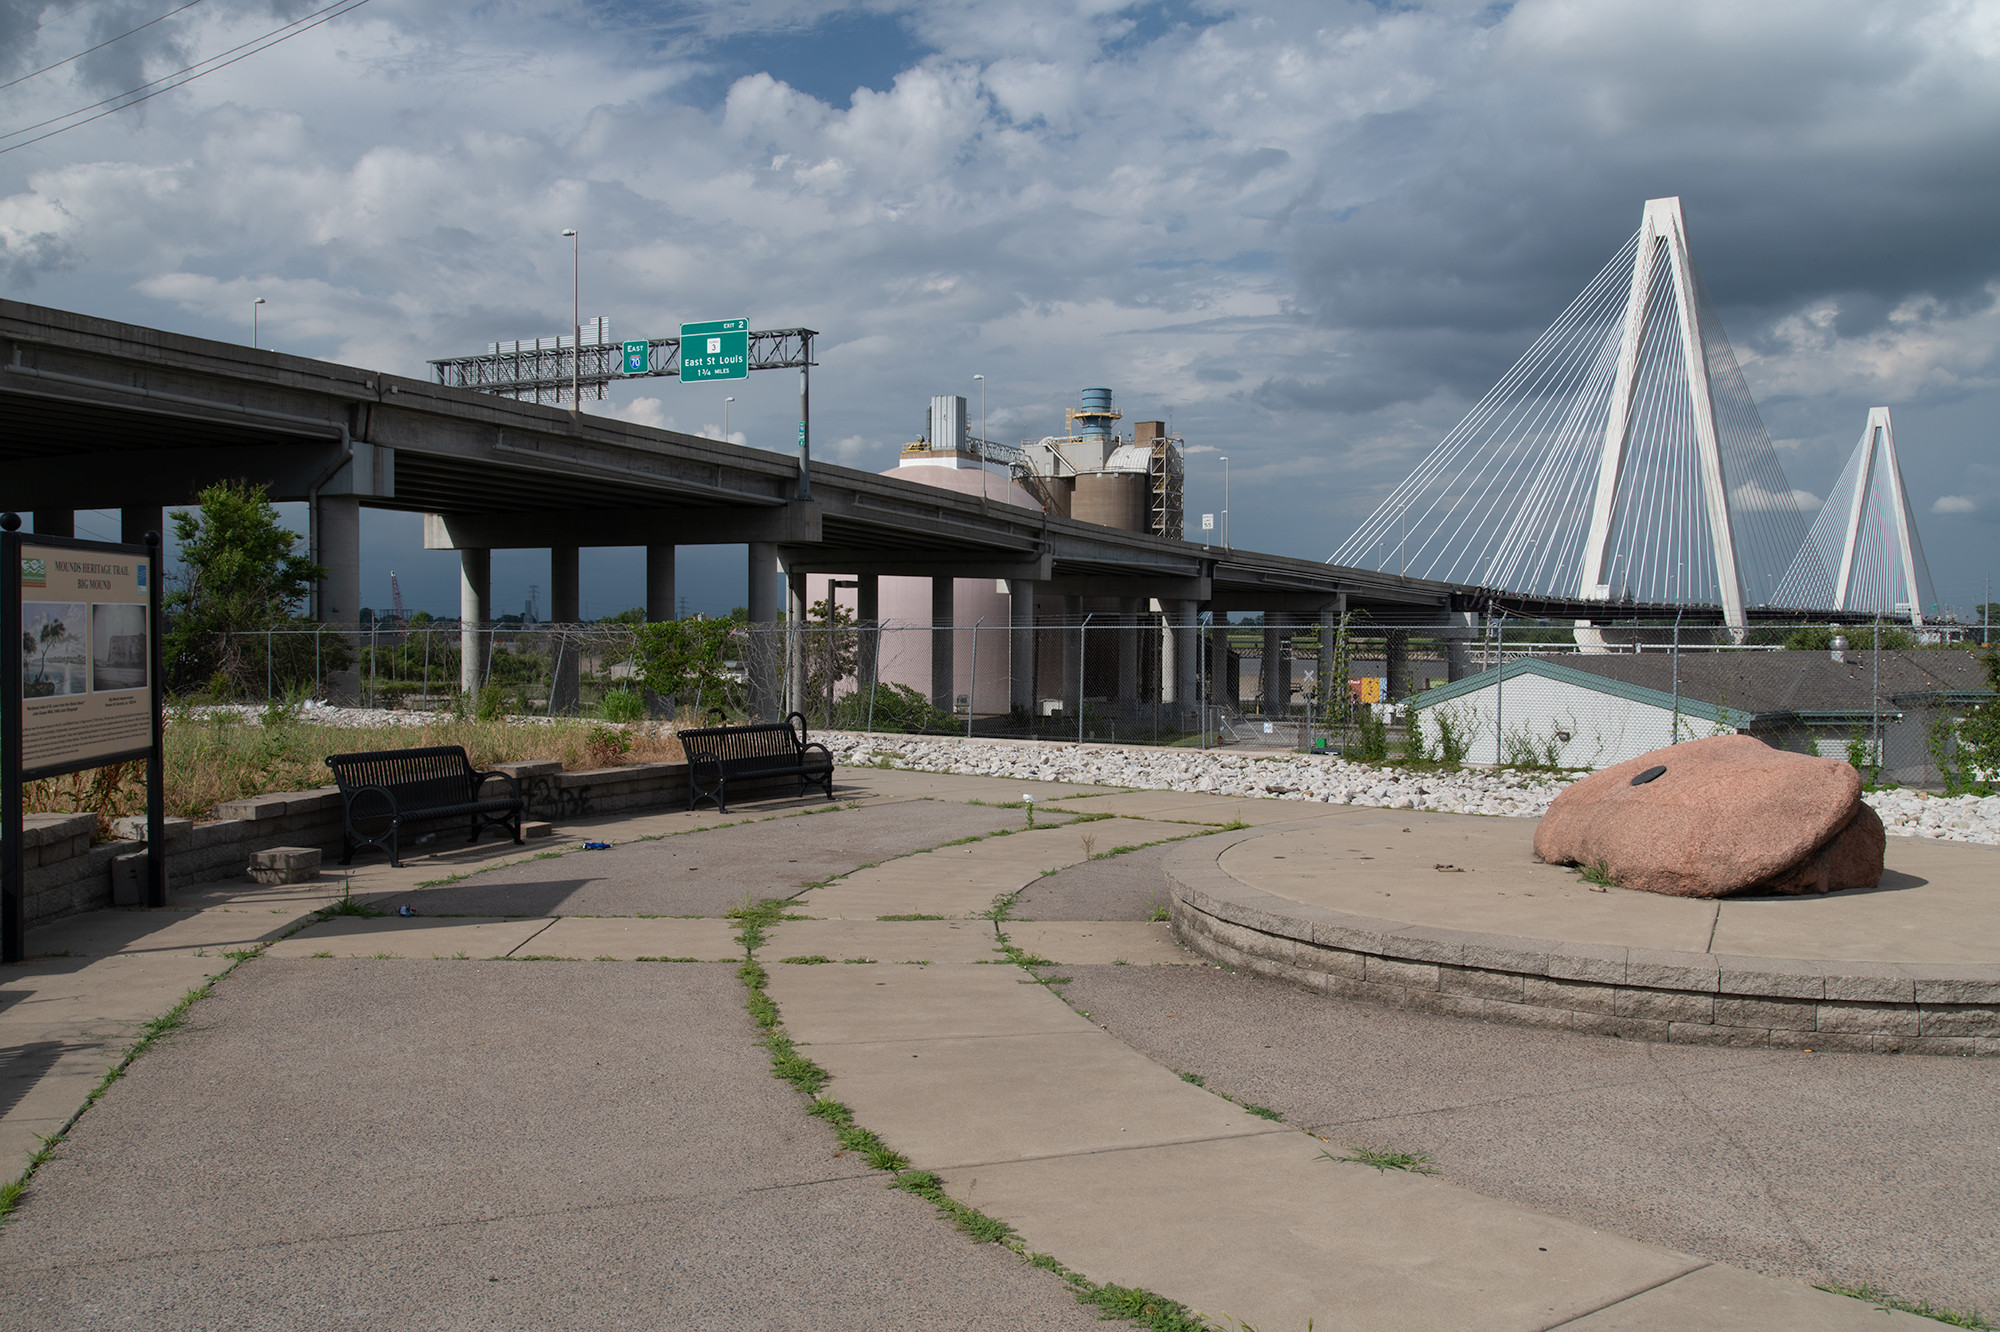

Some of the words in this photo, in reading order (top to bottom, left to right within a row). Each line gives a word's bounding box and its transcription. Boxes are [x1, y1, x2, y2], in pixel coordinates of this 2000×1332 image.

[738, 321, 744, 329] 2
[631, 358, 641, 367] 70
[684, 358, 703, 367] East
[706, 357, 716, 365] St
[719, 355, 743, 364] Louis
[55, 561, 82, 573] MOUNDS
[82, 563, 111, 575] HERITAGE
[112, 565, 130, 576] TRAIL
[77, 579, 89, 589] BIG
[89, 580, 111, 590] MOUND
